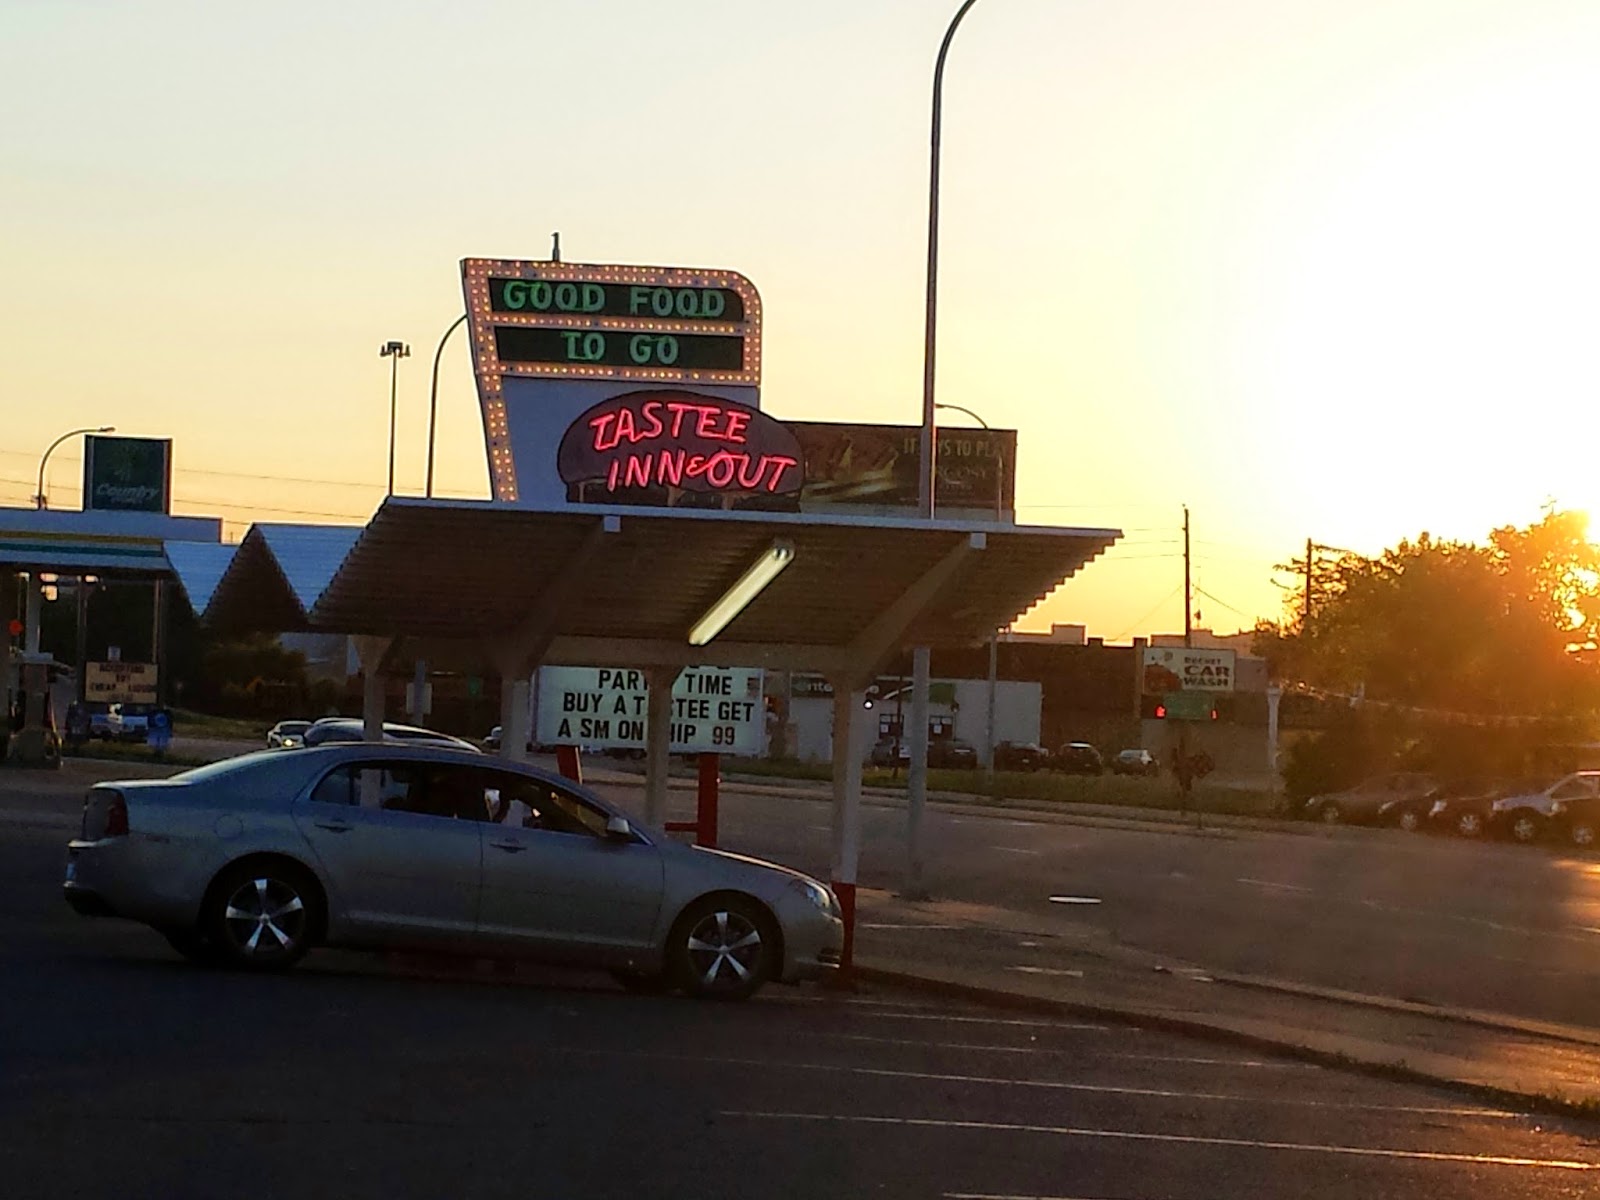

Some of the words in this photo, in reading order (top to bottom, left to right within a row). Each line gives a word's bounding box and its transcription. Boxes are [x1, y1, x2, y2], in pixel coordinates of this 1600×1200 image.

[503, 281, 606, 313] GOOD
[629, 286, 726, 318] FOOD
[561, 331, 606, 361] TO
[629, 333, 679, 365] GO
[590, 402, 752, 451] TASTEE
[684, 673, 733, 696] TIME
[1183, 677, 1229, 687] WASH
[1184, 665, 1230, 678] CAR
[563, 692, 603, 714] BUY
[613, 695, 627, 715] A
[633, 696, 709, 719] TTEE
[718, 701, 755, 722] GET
[558, 718, 572, 738] A
[580, 718, 610, 739] SM
[712, 725, 735, 746] 99
